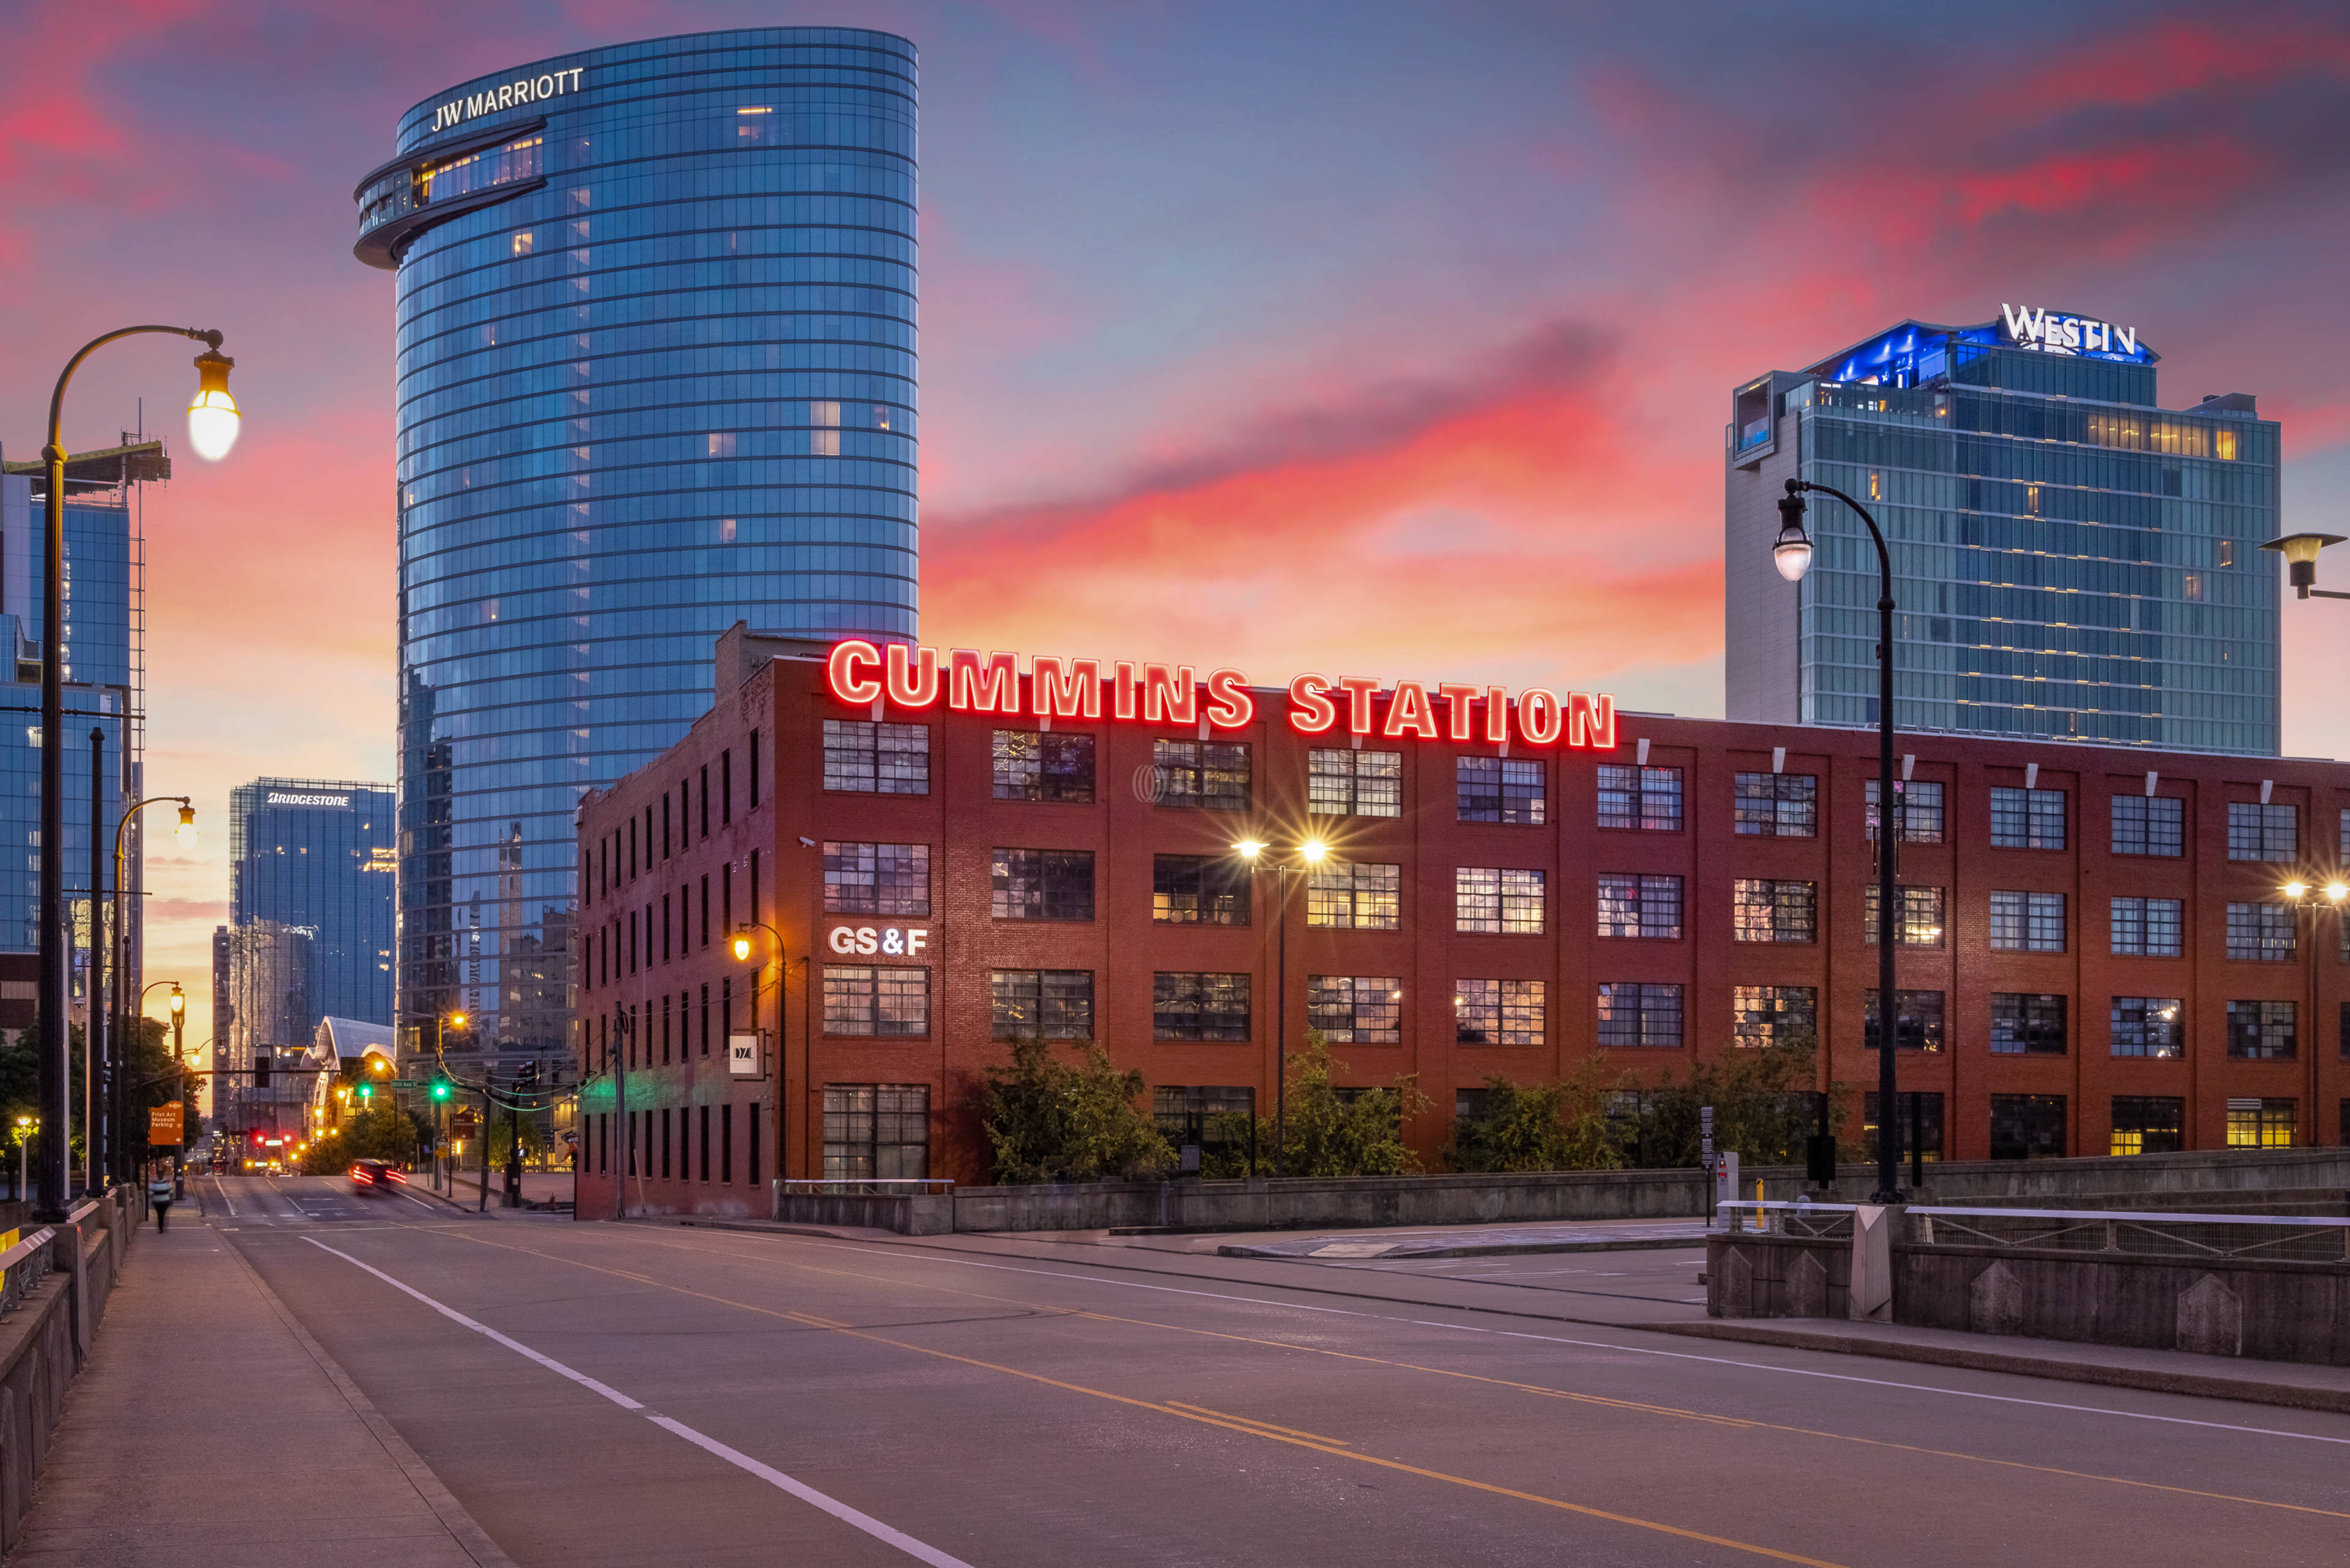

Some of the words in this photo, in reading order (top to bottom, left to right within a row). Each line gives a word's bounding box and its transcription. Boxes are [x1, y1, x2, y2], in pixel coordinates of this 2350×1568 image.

[432, 99, 463, 132] JW
[467, 67, 583, 119] MARRIOTT
[829, 639, 1253, 728] CUMMINS
[1289, 672, 1616, 748] STATION
[267, 792, 349, 807] BRIDGESTONE
[829, 926, 928, 956] GS&F
